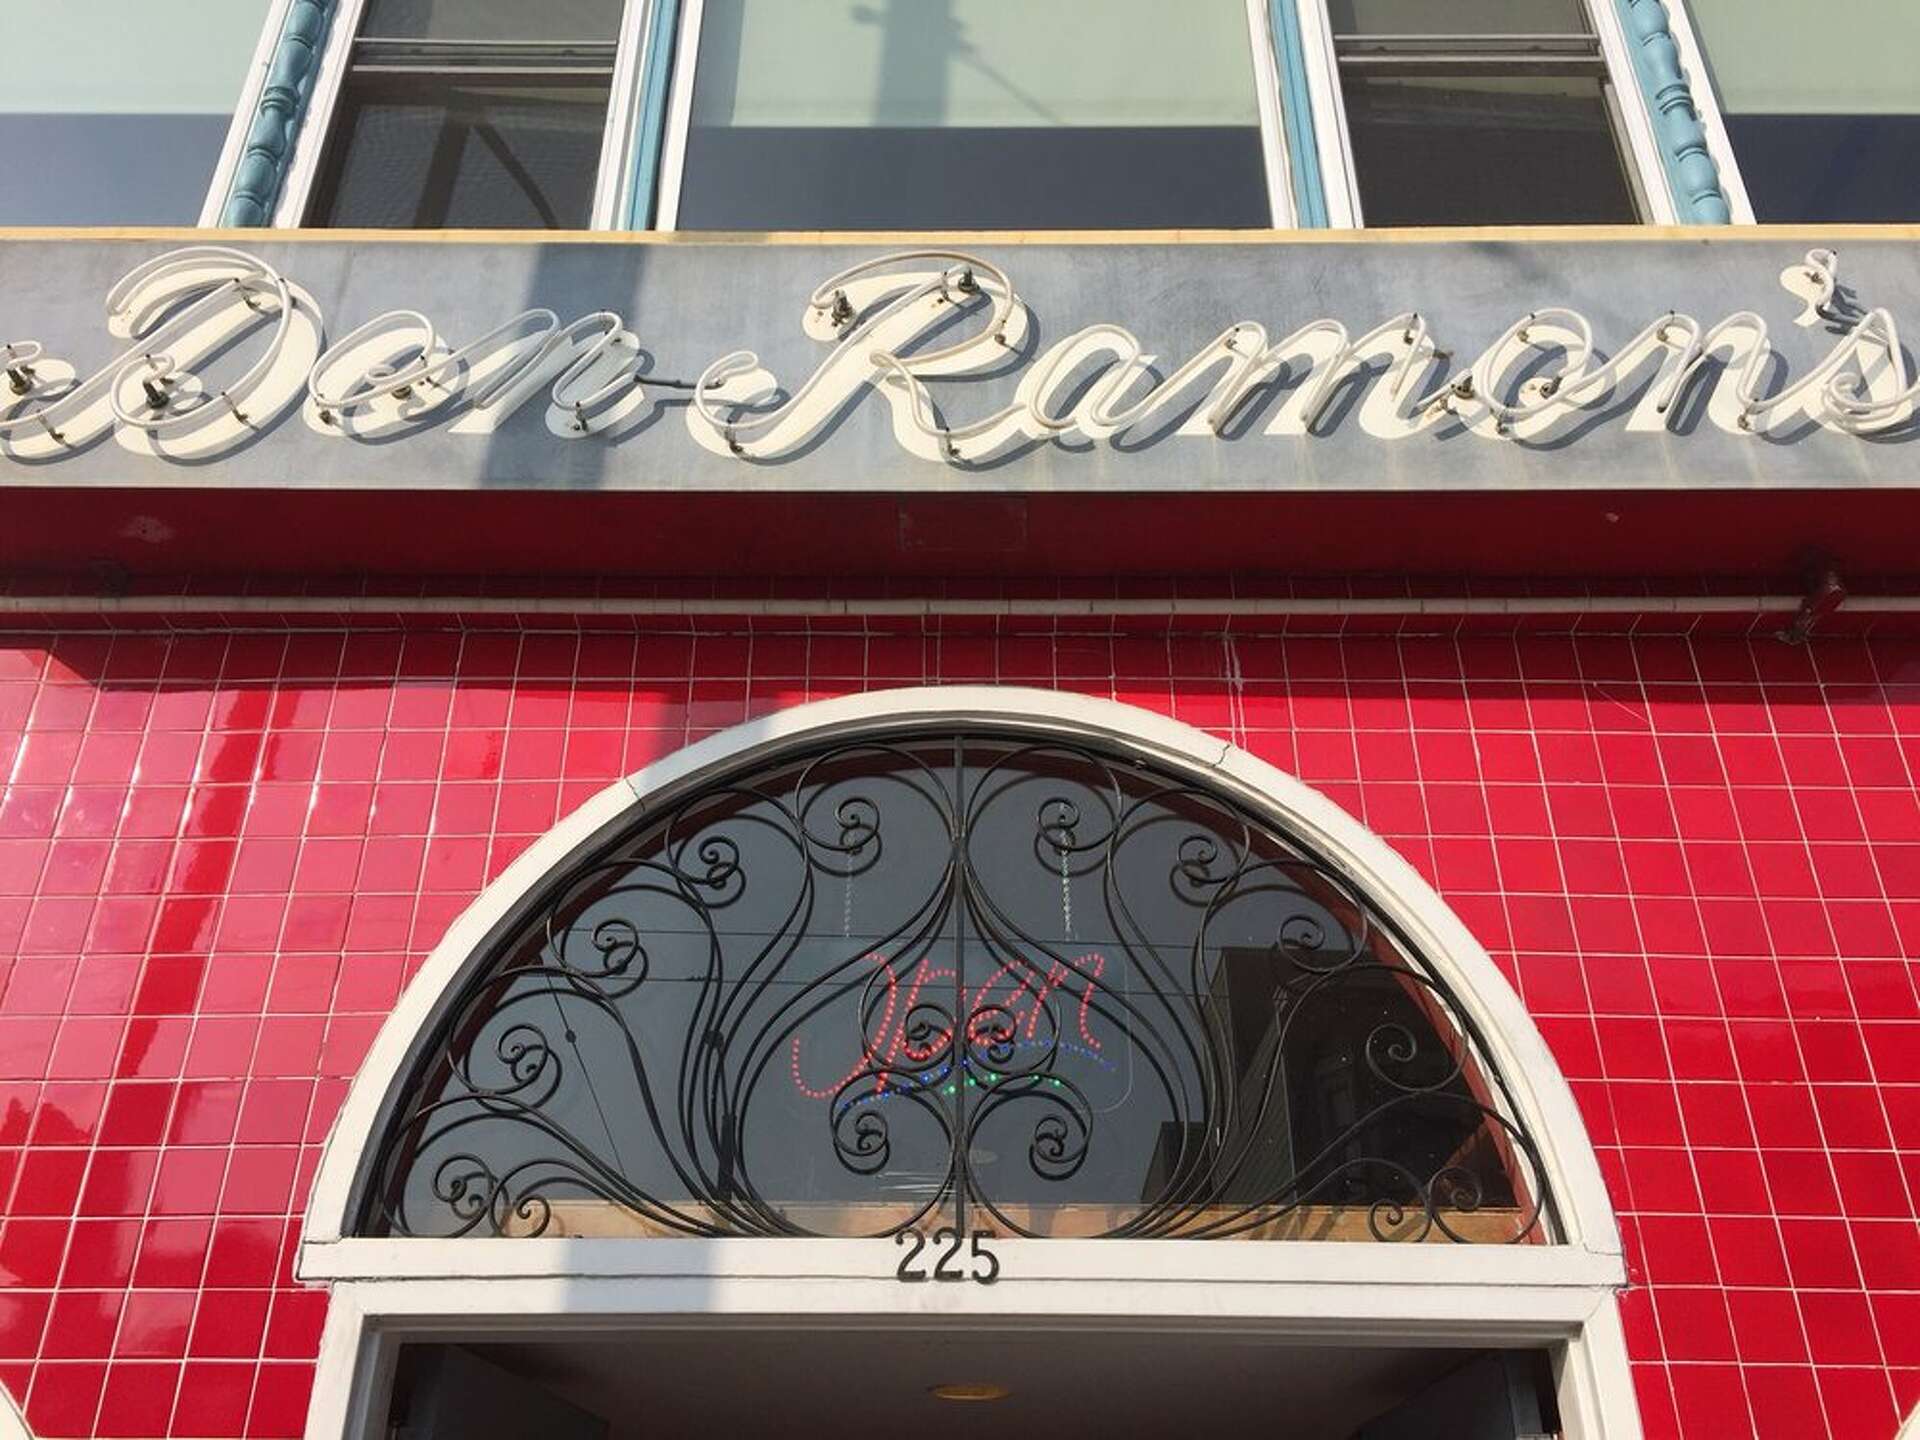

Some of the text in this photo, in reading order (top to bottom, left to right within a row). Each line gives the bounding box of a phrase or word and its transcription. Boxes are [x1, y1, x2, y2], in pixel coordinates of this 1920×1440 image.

[0, 247, 1920, 464] Don Ramon's
[895, 1226, 1000, 1284] 225
